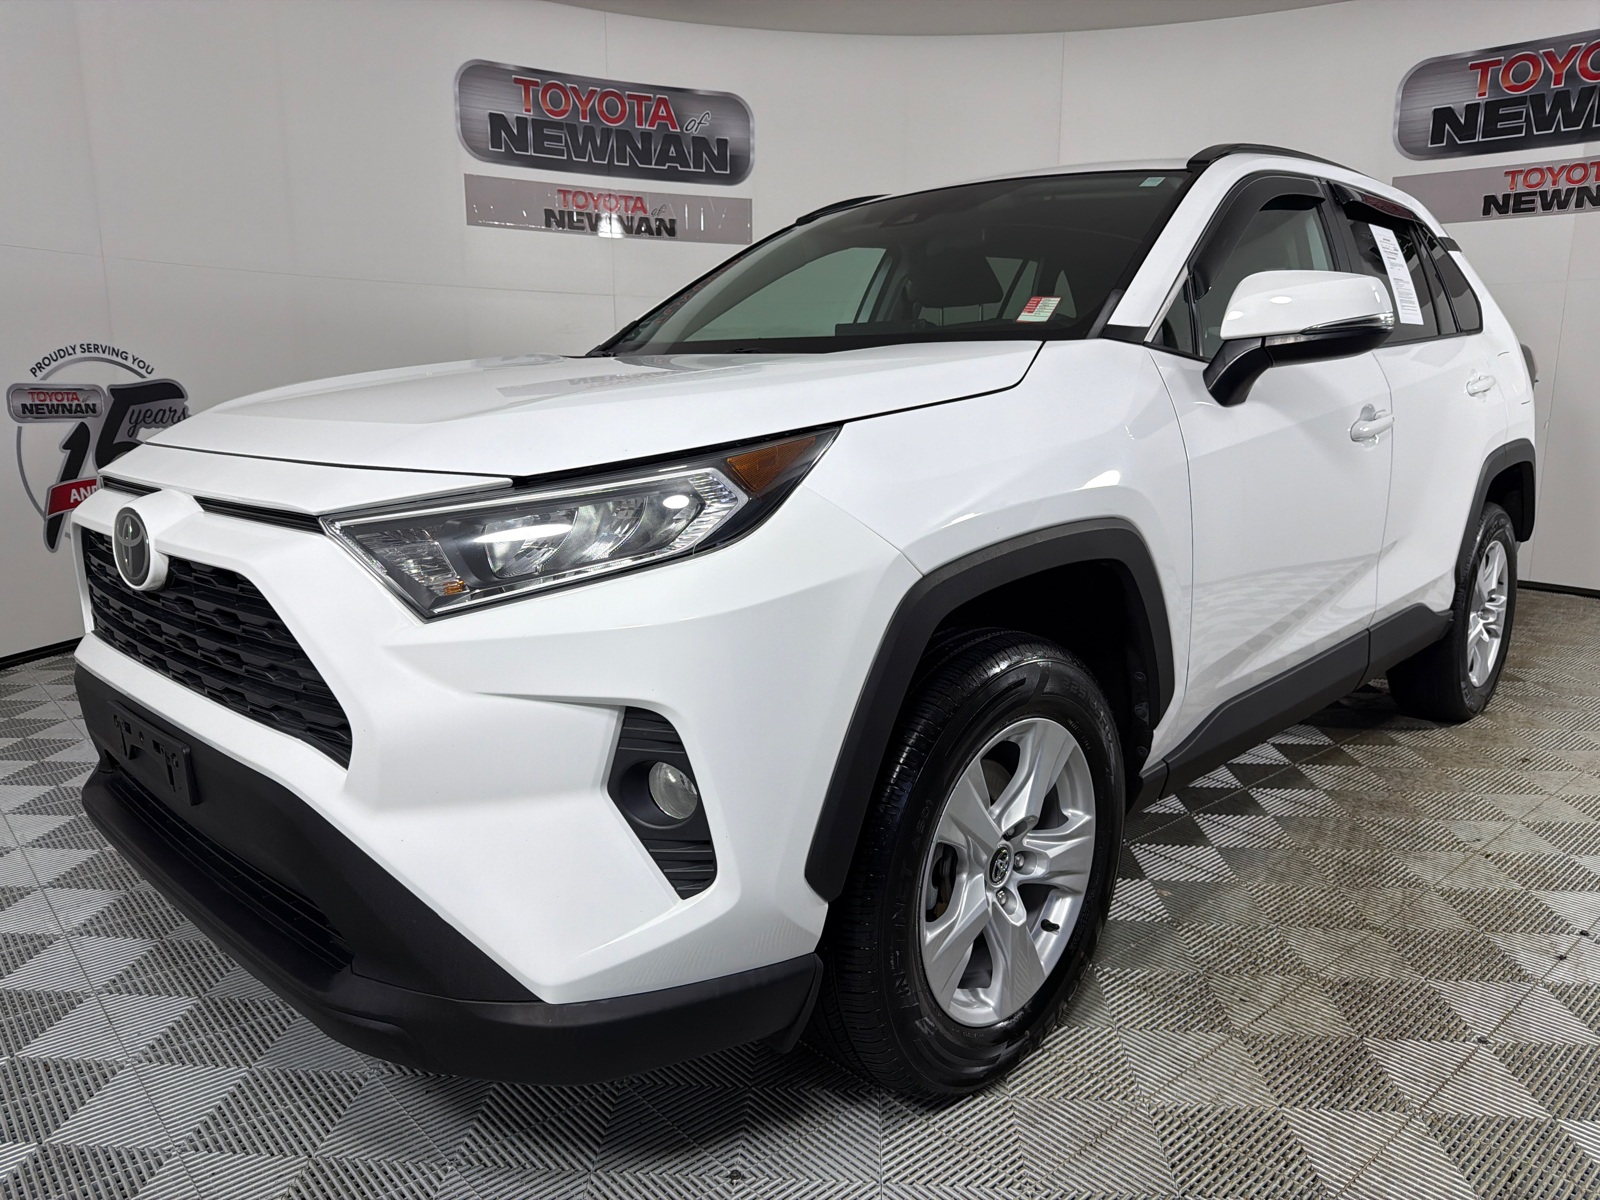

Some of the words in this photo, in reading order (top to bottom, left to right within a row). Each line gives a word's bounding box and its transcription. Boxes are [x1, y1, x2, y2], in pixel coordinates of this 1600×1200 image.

[512, 75, 680, 132] TOYOTA
[683, 110, 711, 134] of
[1428, 84, 1600, 147] NEW
[488, 111, 730, 174] NEWNAN
[556, 188, 648, 215] TOYOTA
[29, 344, 77, 378] PROUDLY
[79, 343, 129, 361] SERVING
[131, 354, 155, 375] YOU
[20, 403, 97, 415] NEWNAN
[28, 391, 80, 402] TOYOTA
[127, 406, 188, 438] years
